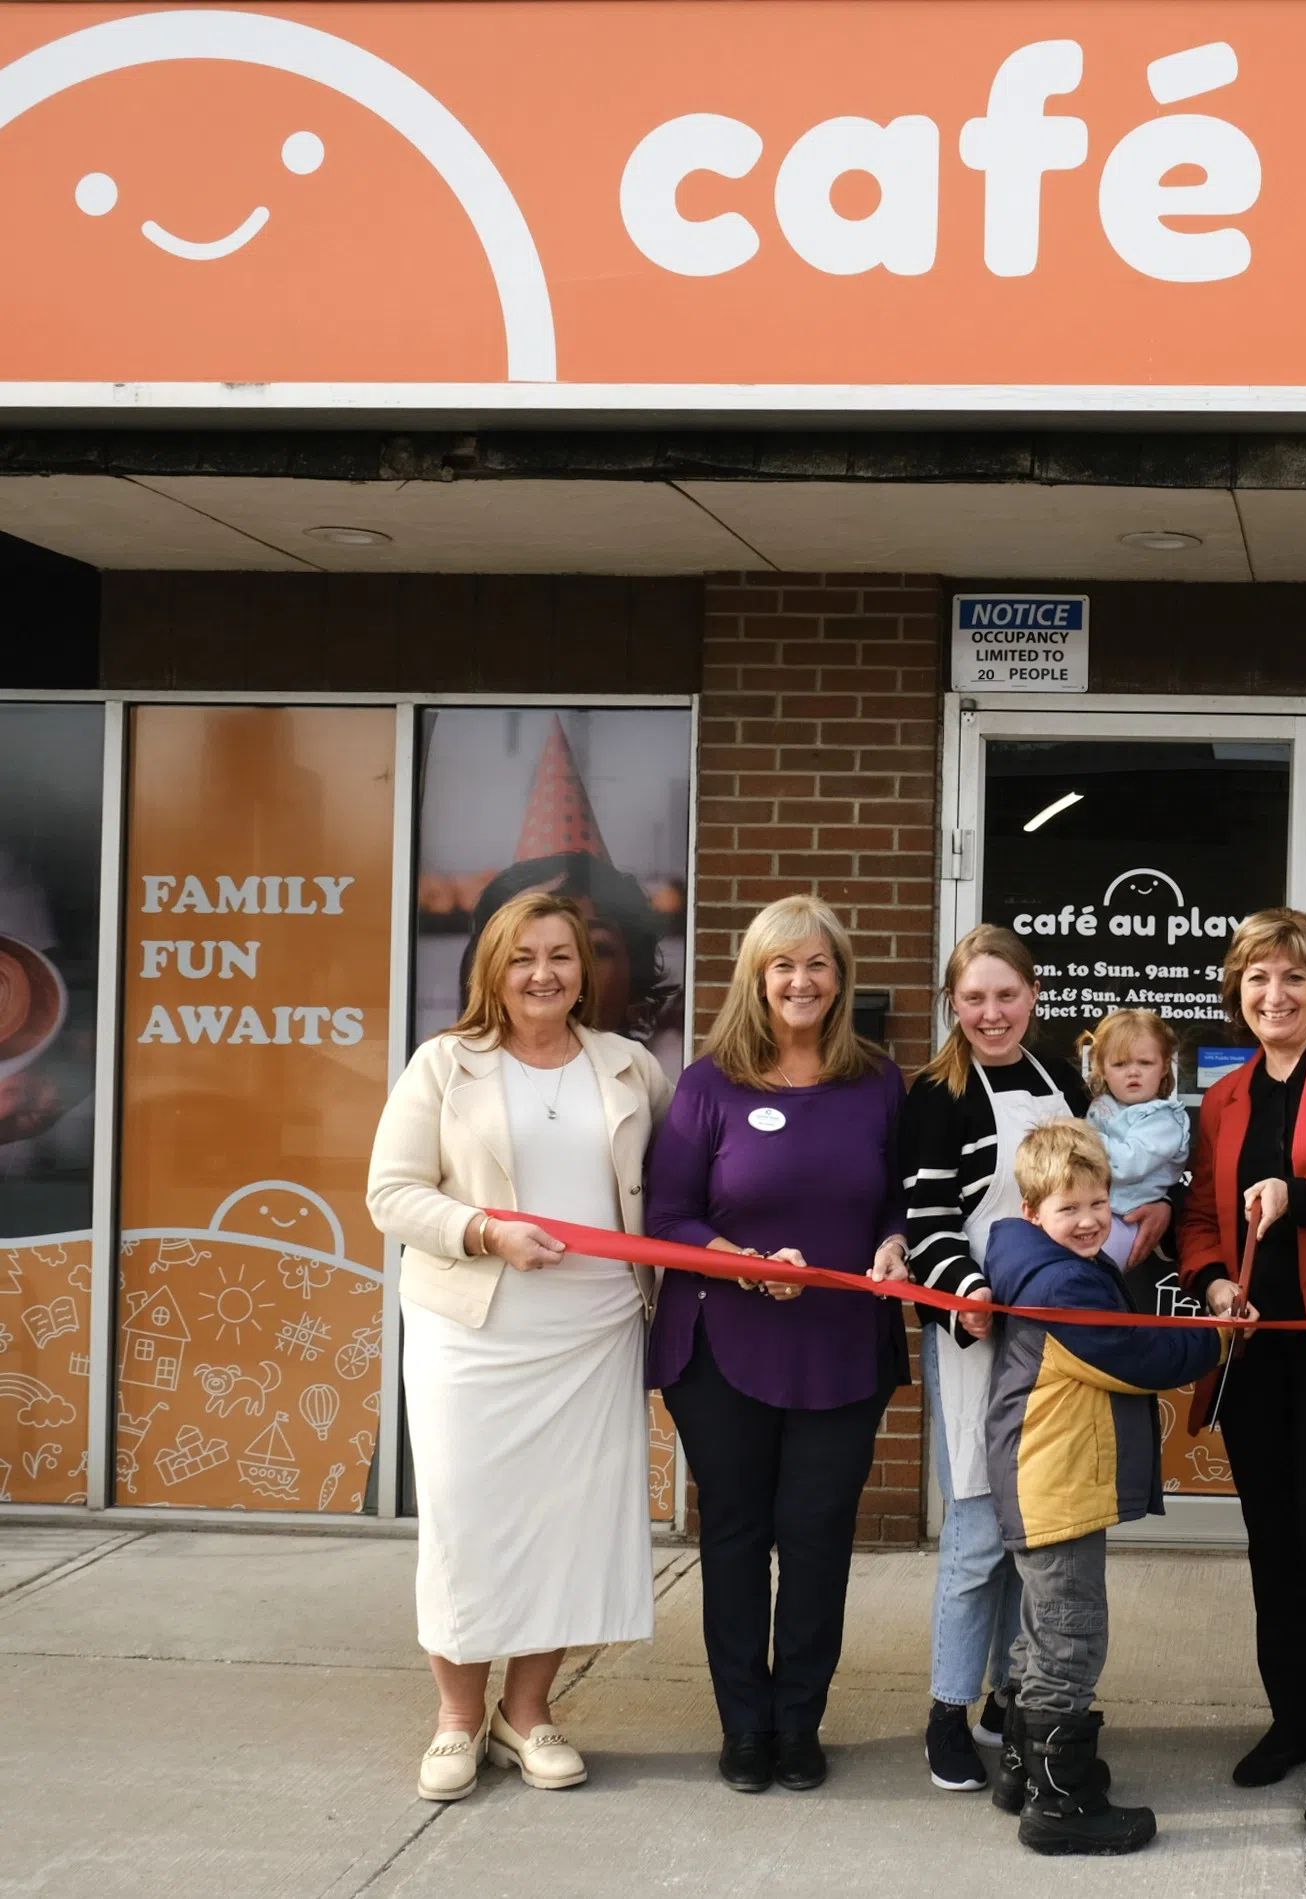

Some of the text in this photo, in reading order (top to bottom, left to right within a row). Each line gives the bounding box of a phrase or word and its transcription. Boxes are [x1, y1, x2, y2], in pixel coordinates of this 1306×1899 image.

[619, 39, 1262, 283] café
[971, 603, 1070, 626] NOTICE
[971, 631, 1069, 644] OCCUPANCY
[976, 649, 1064, 662] LIMITED TO
[977, 668, 1068, 681] 20 PEOPLE
[141, 874, 355, 915] FAMILY
[1013, 905, 1098, 936] café
[1109, 914, 1156, 936] au
[139, 940, 261, 979] FUN
[1033, 964, 1062, 977] on.
[1067, 962, 1089, 977] to
[1093, 961, 1141, 978] Sun.
[1145, 964, 1189, 980] 9am
[1081, 987, 1121, 1003] Sun.
[1035, 1003, 1078, 1020] bject
[1080, 1004, 1103, 1018] To
[137, 1005, 364, 1046] AWAITS
